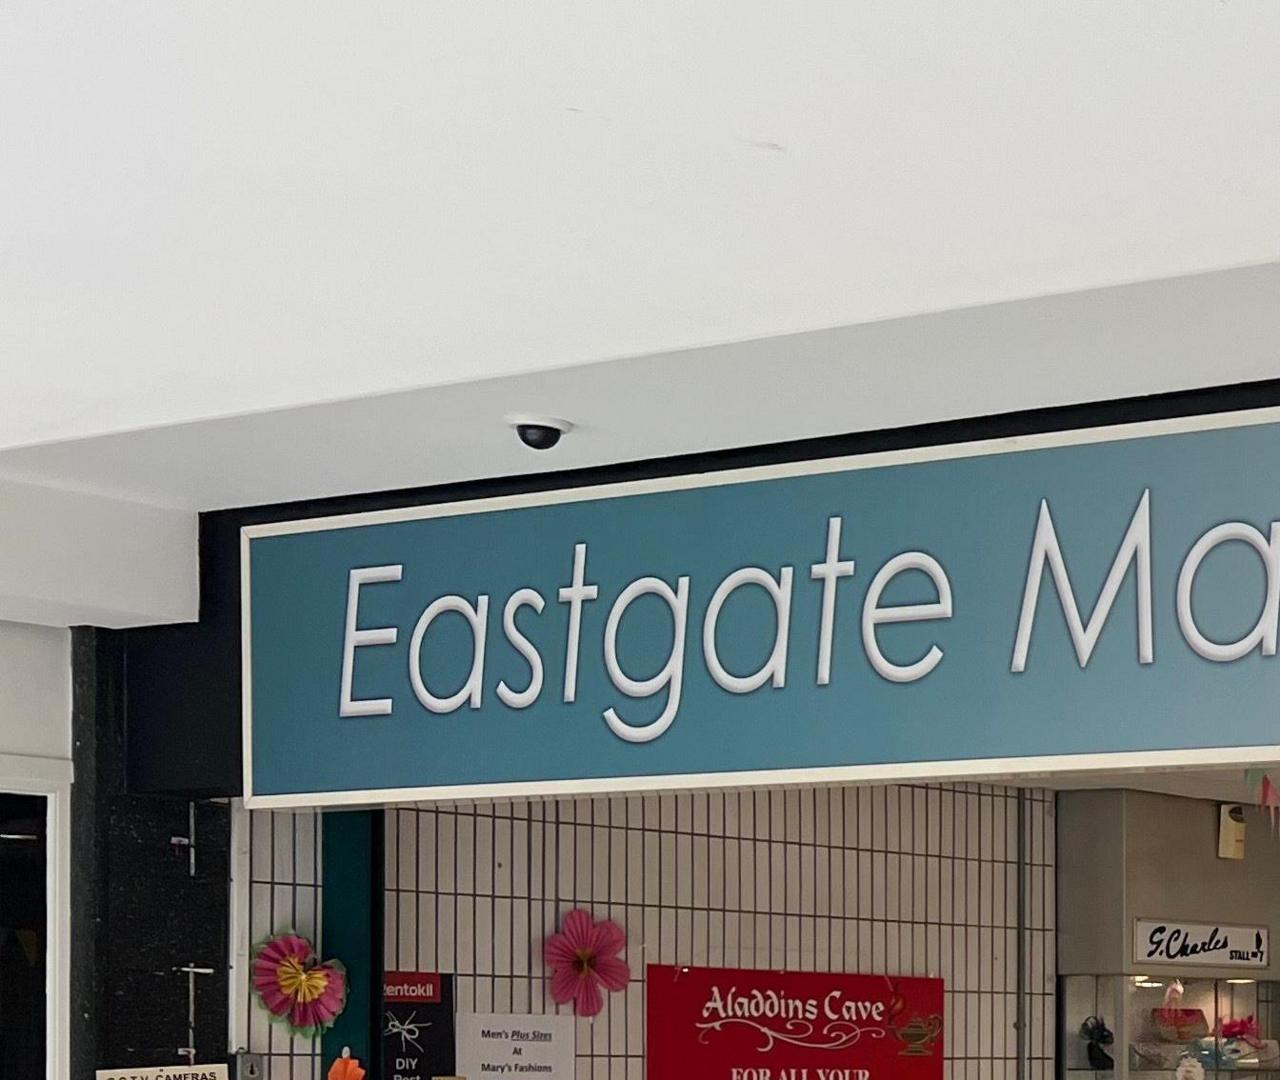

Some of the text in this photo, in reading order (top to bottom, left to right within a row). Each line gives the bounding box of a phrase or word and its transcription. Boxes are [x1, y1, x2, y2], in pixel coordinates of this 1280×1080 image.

[338, 516, 955, 744] Eastgate
[1229, 950, 1251, 961] STALL
[702, 985, 885, 1022] Aladdins Cave
[481, 1029, 552, 1041] Men's Plus Sizes
[512, 1047, 522, 1056] At
[395, 1058, 418, 1070] DIY
[481, 1063, 552, 1074] Mary's Fashions
